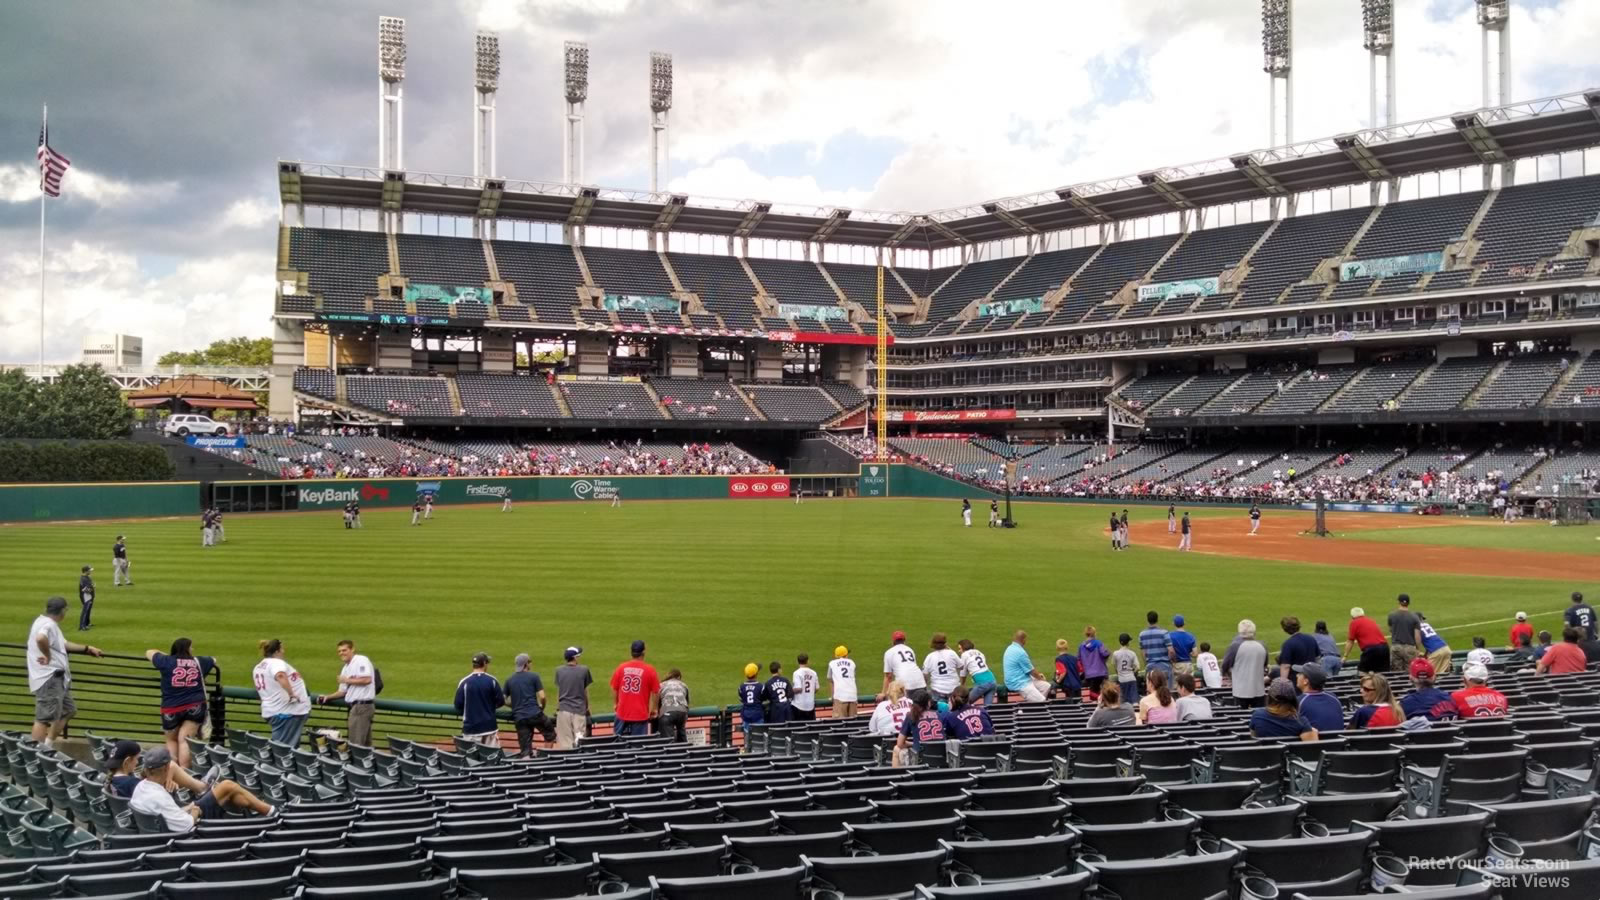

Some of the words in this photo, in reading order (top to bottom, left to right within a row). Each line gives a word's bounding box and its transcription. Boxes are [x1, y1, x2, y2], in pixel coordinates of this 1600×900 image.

[1142, 286, 1165, 295] FELLER
[396, 316, 406, 324] VS
[914, 410, 960, 420] Budweiser
[194, 438, 238, 446] PROGRESSIVE
[466, 484, 506, 495] FirstEnergy
[300, 488, 359, 504] KeyBank
[1580, 614, 1589, 626] 2
[897, 650, 915, 662] 13
[937, 661, 948, 675] 2
[974, 656, 986, 669] 2
[1121, 660, 1128, 670] 2
[1207, 661, 1218, 671] 12
[172, 666, 199, 687] 22
[841, 667, 849, 678] 2
[622, 674, 643, 694] 33
[805, 681, 811, 693] 2
[746, 691, 754, 703] 2
[777, 688, 788, 703] 2
[918, 720, 944, 741] 22
[965, 716, 983, 735] 13
